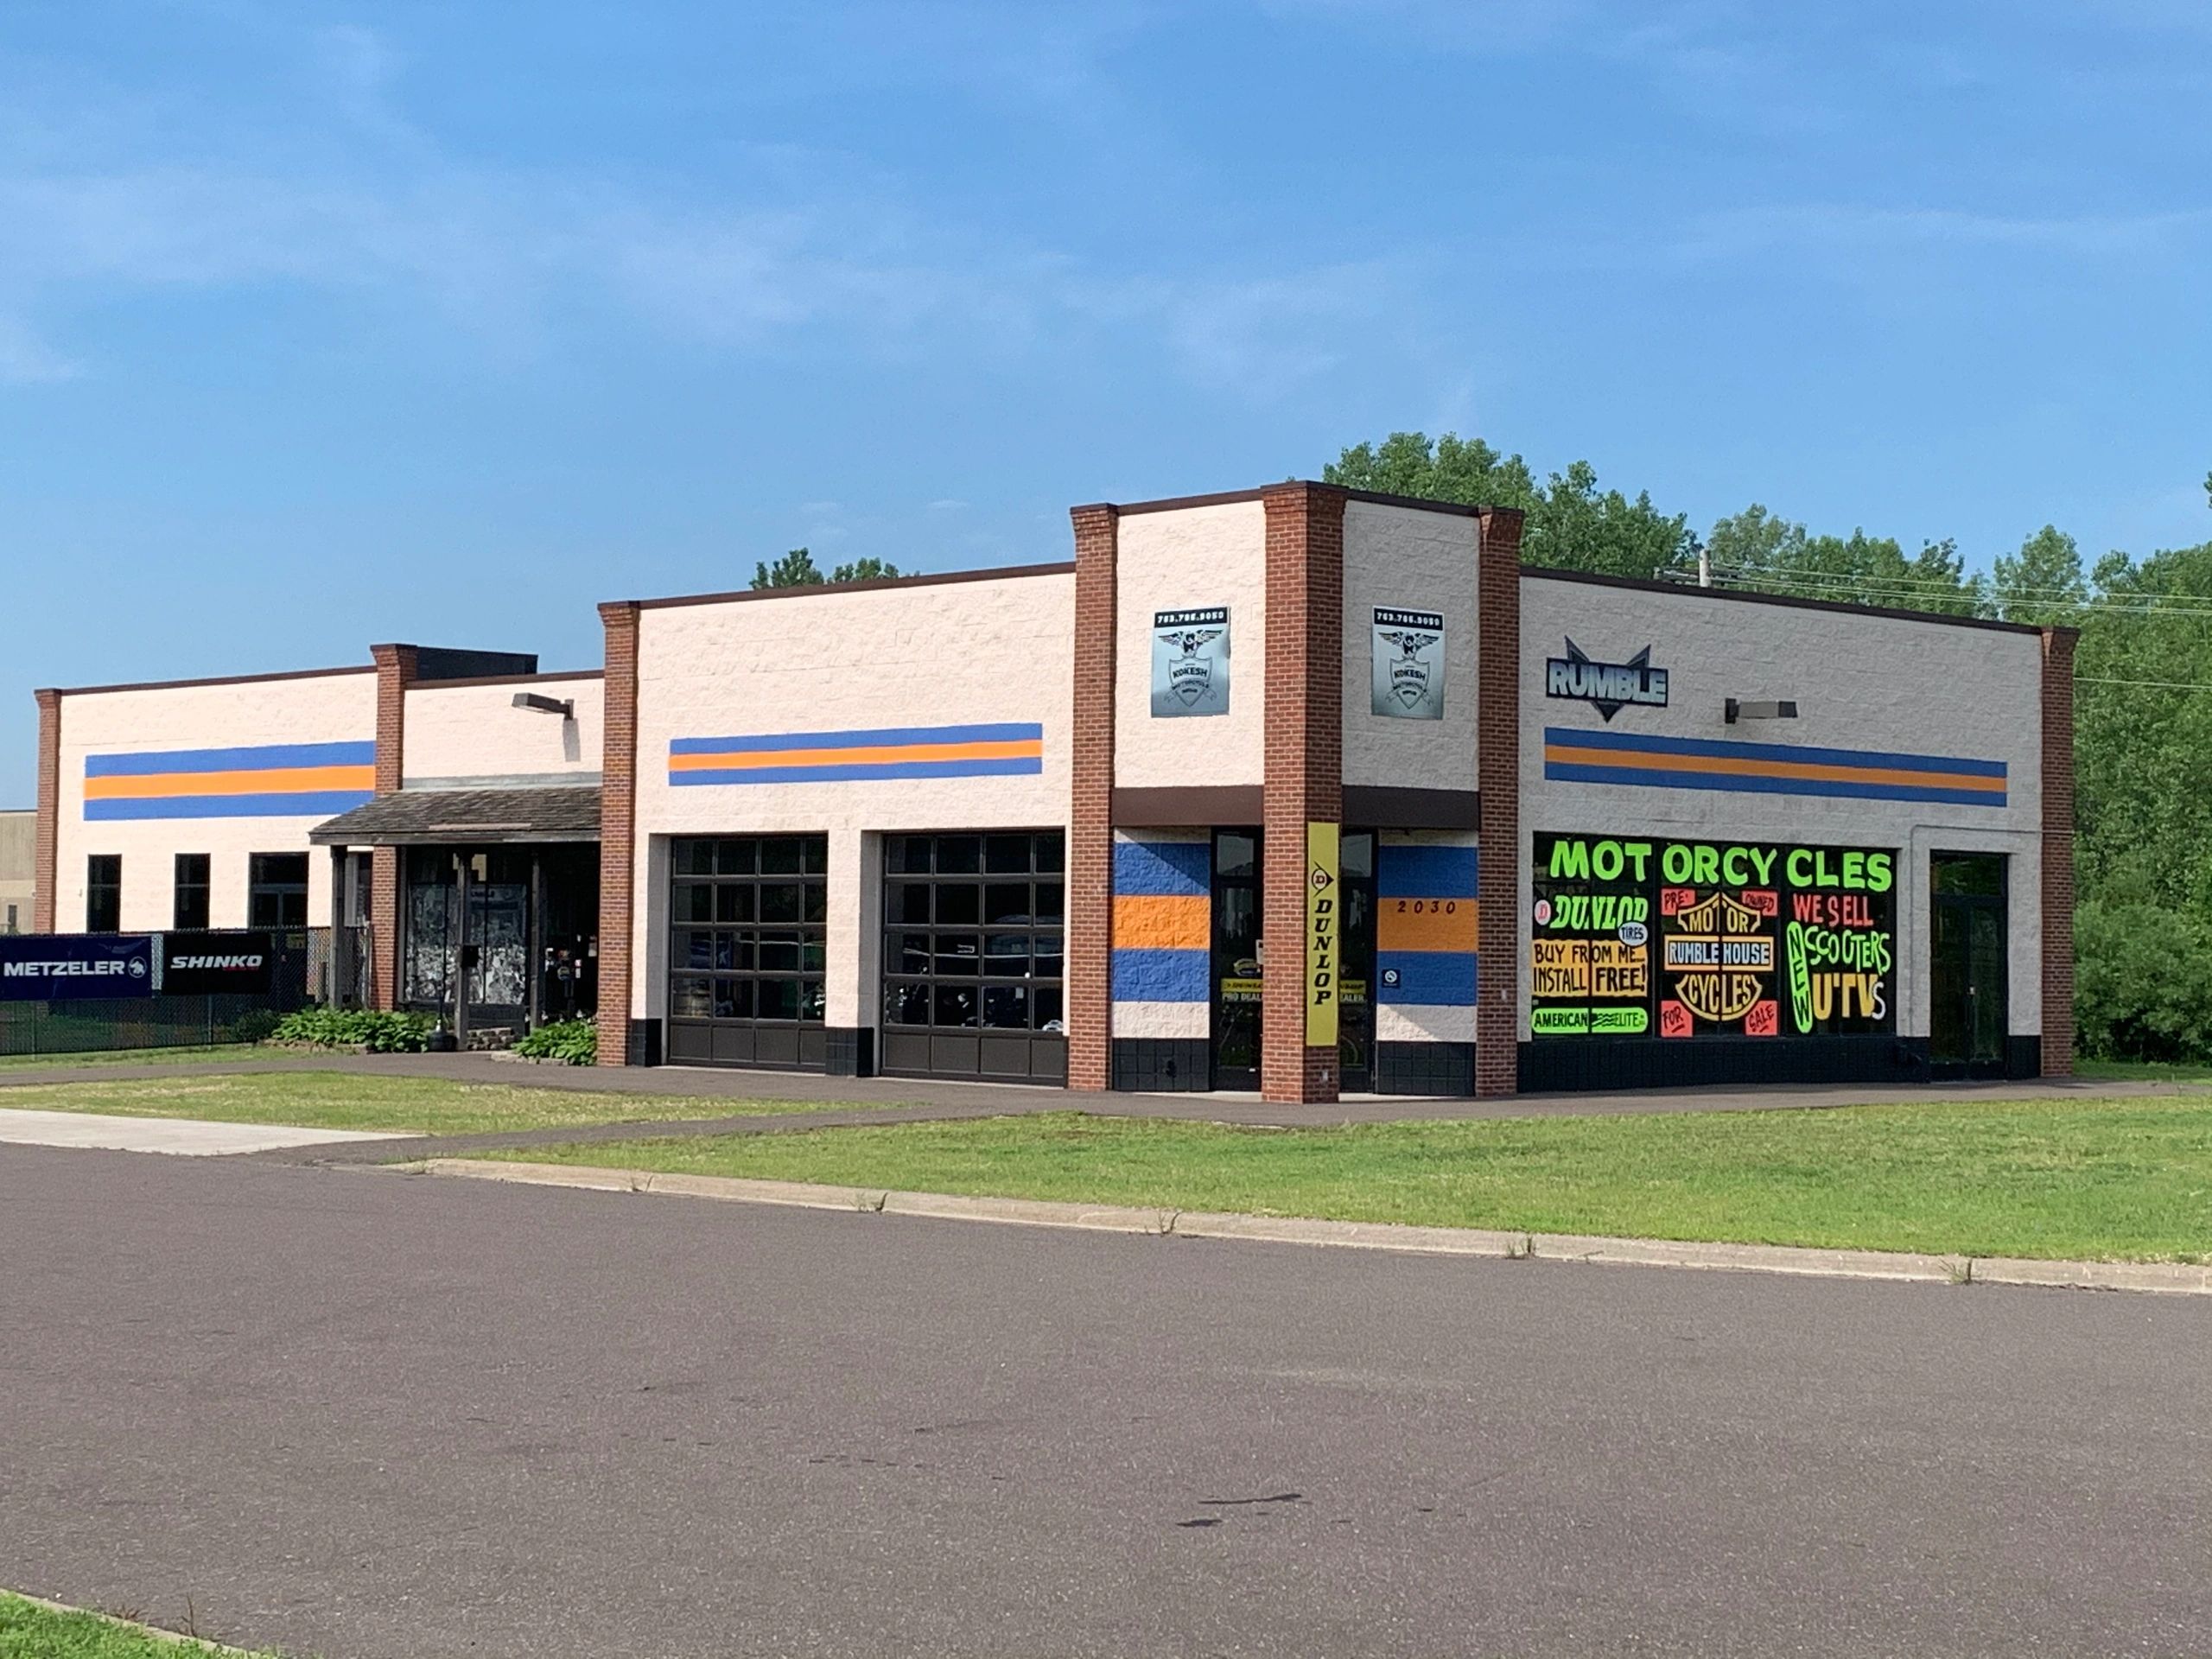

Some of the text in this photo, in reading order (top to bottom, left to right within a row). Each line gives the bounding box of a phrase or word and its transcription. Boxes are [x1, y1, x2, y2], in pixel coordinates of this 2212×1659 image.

[1173, 667, 1208, 678] KOKESH
[1394, 669, 1426, 681] KOKESH
[1548, 661, 1667, 704] RUMBLE
[1397, 900, 1456, 914] 2030
[1549, 894, 1649, 930] DUNLOP
[1689, 899, 1749, 933] MOTOR
[1793, 893, 1874, 927] WE SELL
[1621, 926, 1644, 940] TIRES
[170, 955, 264, 969] SHINKO
[1313, 899, 1332, 1005] DUNLOP
[1535, 944, 1566, 963] BUY
[1573, 944, 1612, 963] FROM
[1669, 942, 1770, 965] RUMBLE HOUSE
[1804, 925, 1891, 976] SCOOTERS
[3, 960, 125, 977] METZELER
[1534, 963, 1646, 993] INSTALL FREE!
[1789, 927, 1810, 1027] NEW
[1222, 993, 1263, 1002] PRO DEAL
[1688, 974, 1751, 1014] CYCLES
[1534, 1013, 1588, 1027] AMERICAN
[1662, 1004, 1775, 1031] FOR SALE
